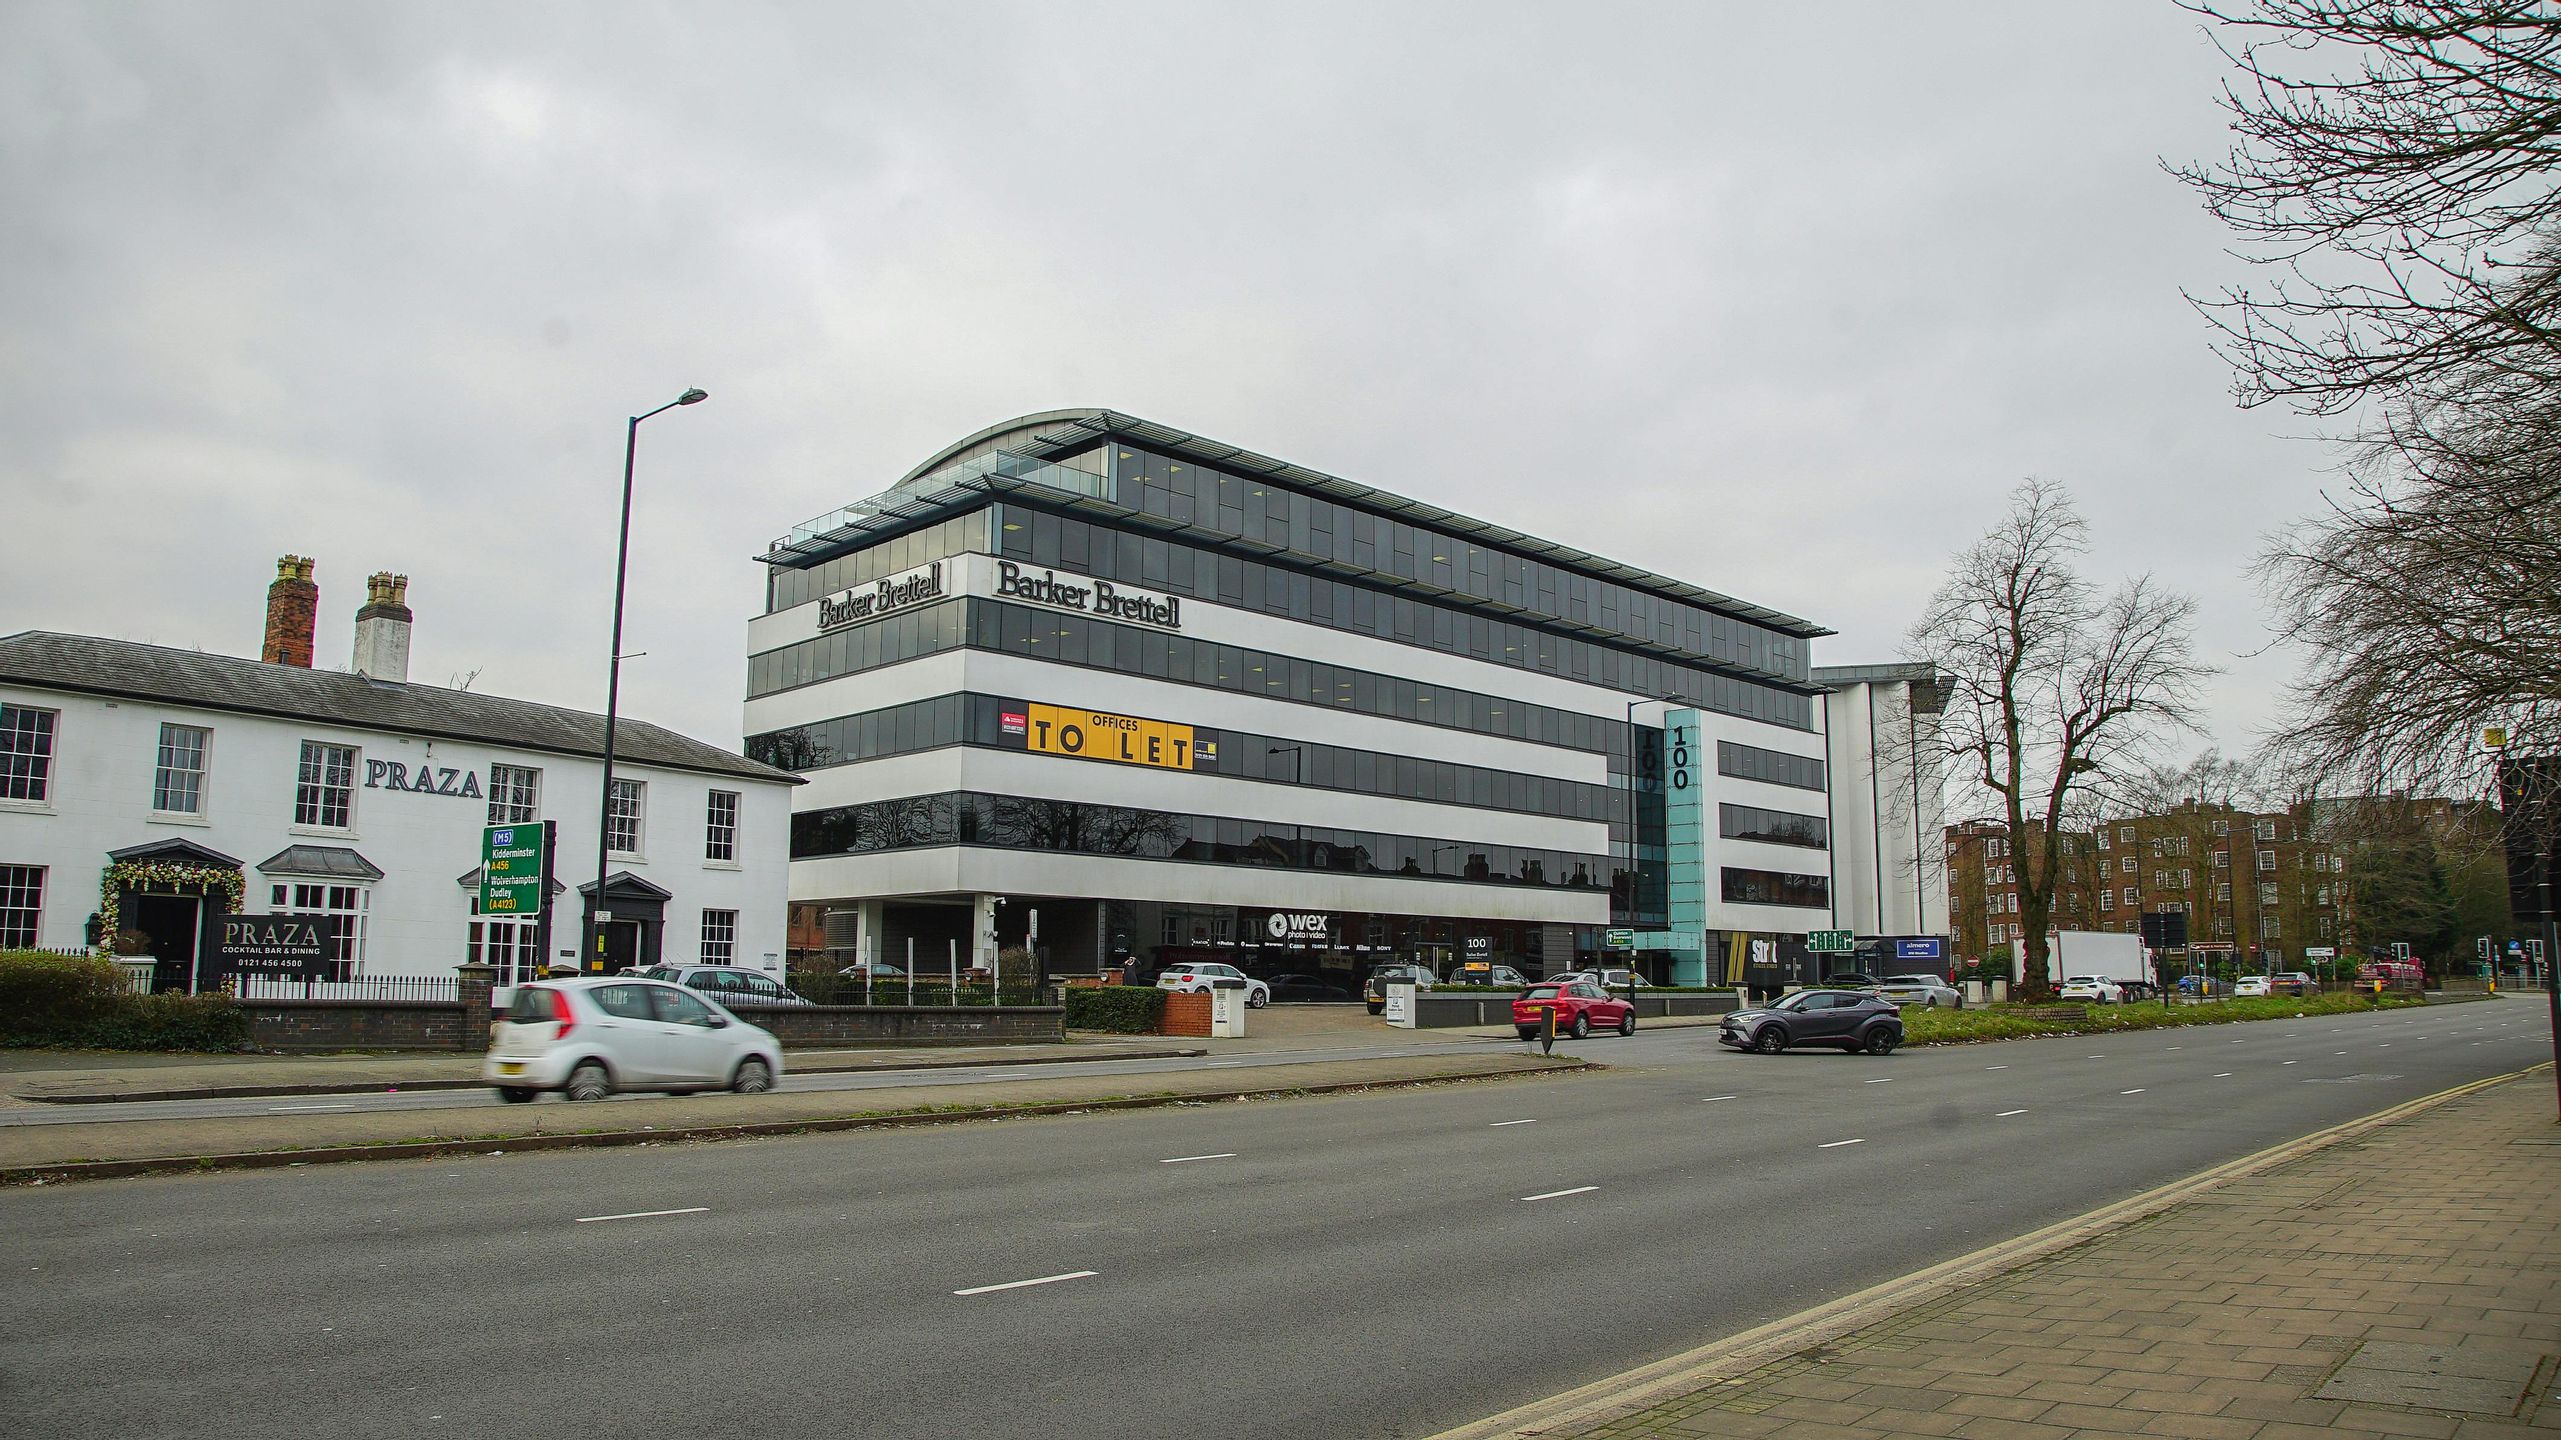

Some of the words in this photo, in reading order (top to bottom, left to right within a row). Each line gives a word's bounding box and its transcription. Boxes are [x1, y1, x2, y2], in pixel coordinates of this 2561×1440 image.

[817, 590, 876, 628] Barker
[875, 562, 942, 611] Brettell
[998, 560, 1091, 610] Barker
[1094, 580, 1181, 628] Brettell
[1092, 714, 1138, 731] OFFICES
[1035, 720, 1084, 753] TO
[1121, 732, 1187, 766] LET
[1673, 725, 1688, 790] 100
[365, 759, 483, 798] PRAZA
[494, 831, 512, 844] (M5)
[492, 847, 535, 859] Kidderminster
[491, 861, 509, 870] A456
[491, 874, 539, 886] Wolverhampton
[490, 888, 512, 899] Dudley
[489, 899, 516, 910] (A4123)
[1288, 914, 1328, 931] wex
[222, 922, 320, 946] PRAZA
[1288, 930, 1306, 939] photo
[1309, 930, 1326, 939] video
[1467, 938, 1486, 948] 100
[222, 946, 262, 954] COCKTAIL
[238, 959, 259, 967] 0121
[262, 959, 278, 967] 456
